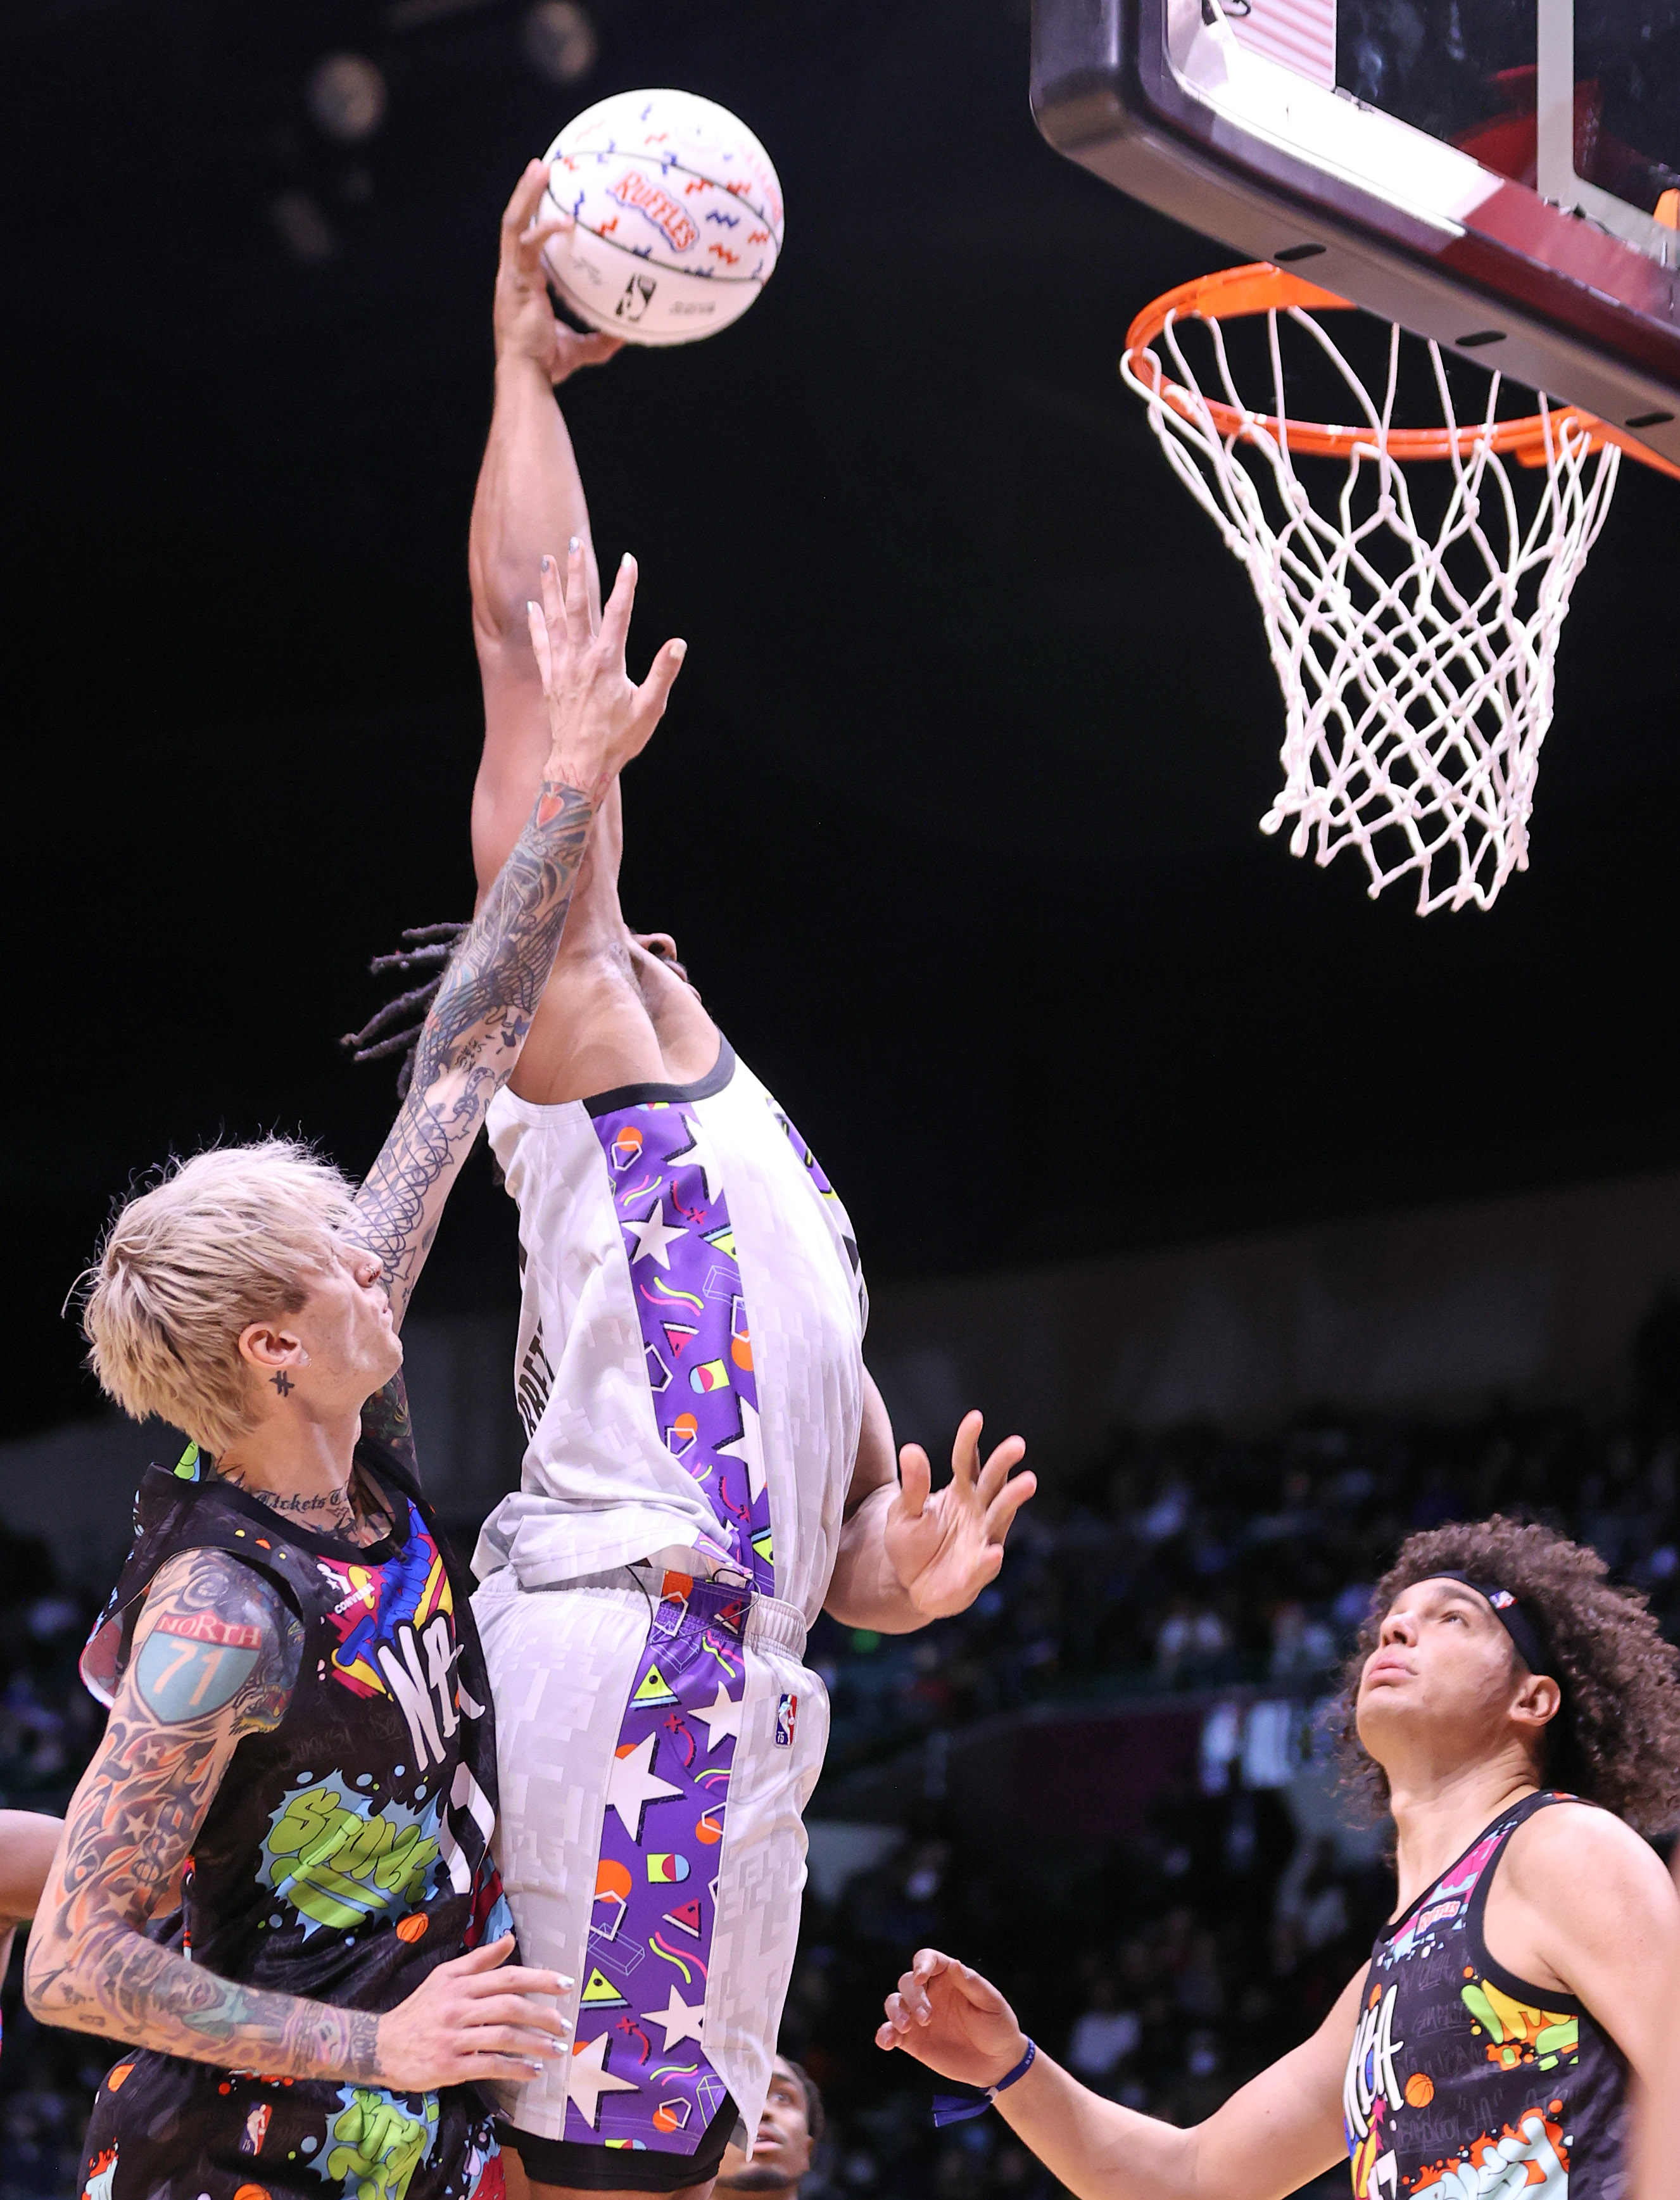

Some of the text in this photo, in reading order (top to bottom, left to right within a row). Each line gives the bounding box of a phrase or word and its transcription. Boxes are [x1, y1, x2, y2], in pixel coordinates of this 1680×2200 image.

[614, 170, 695, 250] RUFFLES
[156, 1614, 260, 1645] NORTH
[153, 1640, 225, 1706] 71
[1419, 1901, 1460, 1928] RUFFLES
